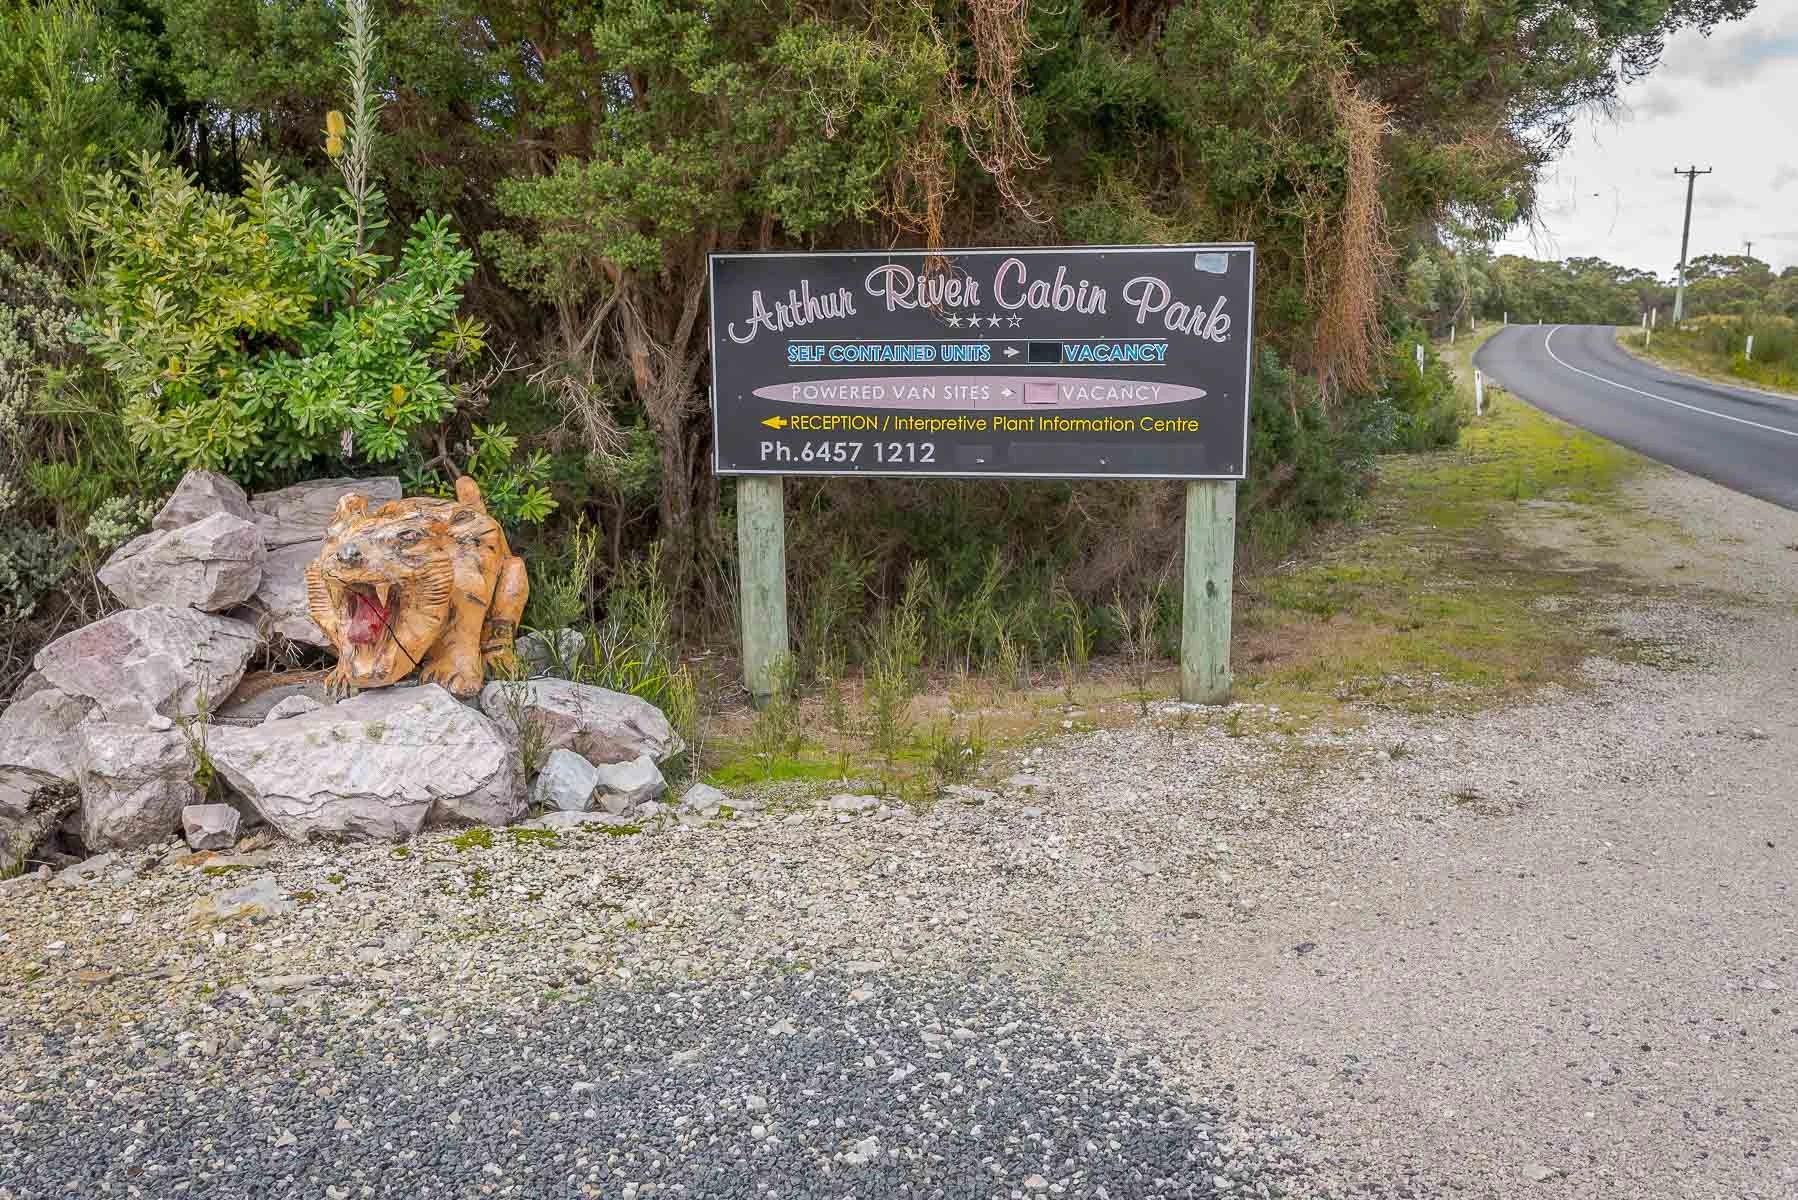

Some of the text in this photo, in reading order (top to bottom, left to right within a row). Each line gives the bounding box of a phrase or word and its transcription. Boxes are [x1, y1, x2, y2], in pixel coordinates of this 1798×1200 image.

[728, 257, 1232, 344] Arthur River Cabin Park
[787, 343, 1169, 362] SELF CONTAINED UNITS VACANCY
[791, 384, 1161, 401] POWERED VAN SITES VACANCY
[790, 415, 878, 431] RECEPTION
[894, 414, 987, 433] Interpretive
[993, 415, 1035, 432] Plant
[1039, 415, 1135, 432] Information
[1139, 416, 1199, 432] Centre
[873, 441, 936, 463] 1212
